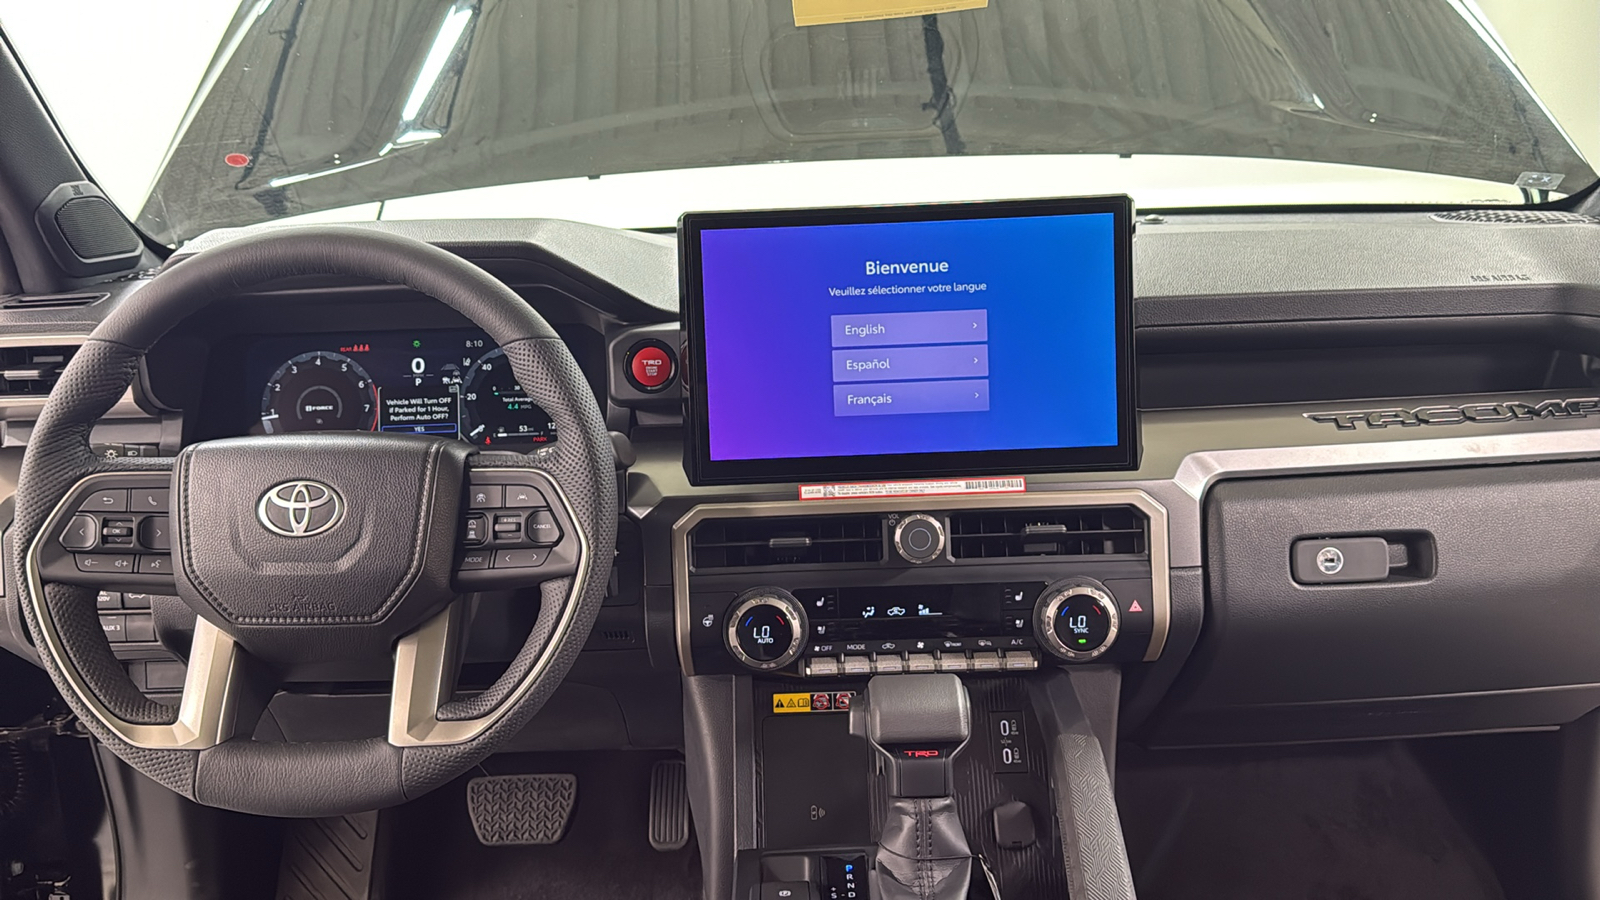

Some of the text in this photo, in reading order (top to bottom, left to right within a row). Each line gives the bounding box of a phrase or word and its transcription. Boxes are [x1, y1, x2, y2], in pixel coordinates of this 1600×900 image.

[865, 260, 949, 275] Bienvenue
[828, 281, 987, 297] Veuillez sélectionner votre langue
[845, 323, 886, 337] English
[466, 340, 483, 348] 8:10
[341, 363, 348, 372] 5
[412, 357, 426, 374] 0
[481, 363, 492, 371] 40
[846, 358, 891, 372] Español
[291, 366, 298, 374] 3
[358, 381, 365, 389] 6
[415, 378, 422, 386] P
[274, 383, 281, 391] 2
[466, 393, 477, 401] 20
[847, 393, 892, 406] Français
[363, 404, 370, 412] 7
[1011, 638, 1023, 646] A/C
[820, 644, 833, 652] OFF
[846, 643, 866, 651] MODE
[903, 750, 939, 758] TRD
[845, 864, 853, 872] P
